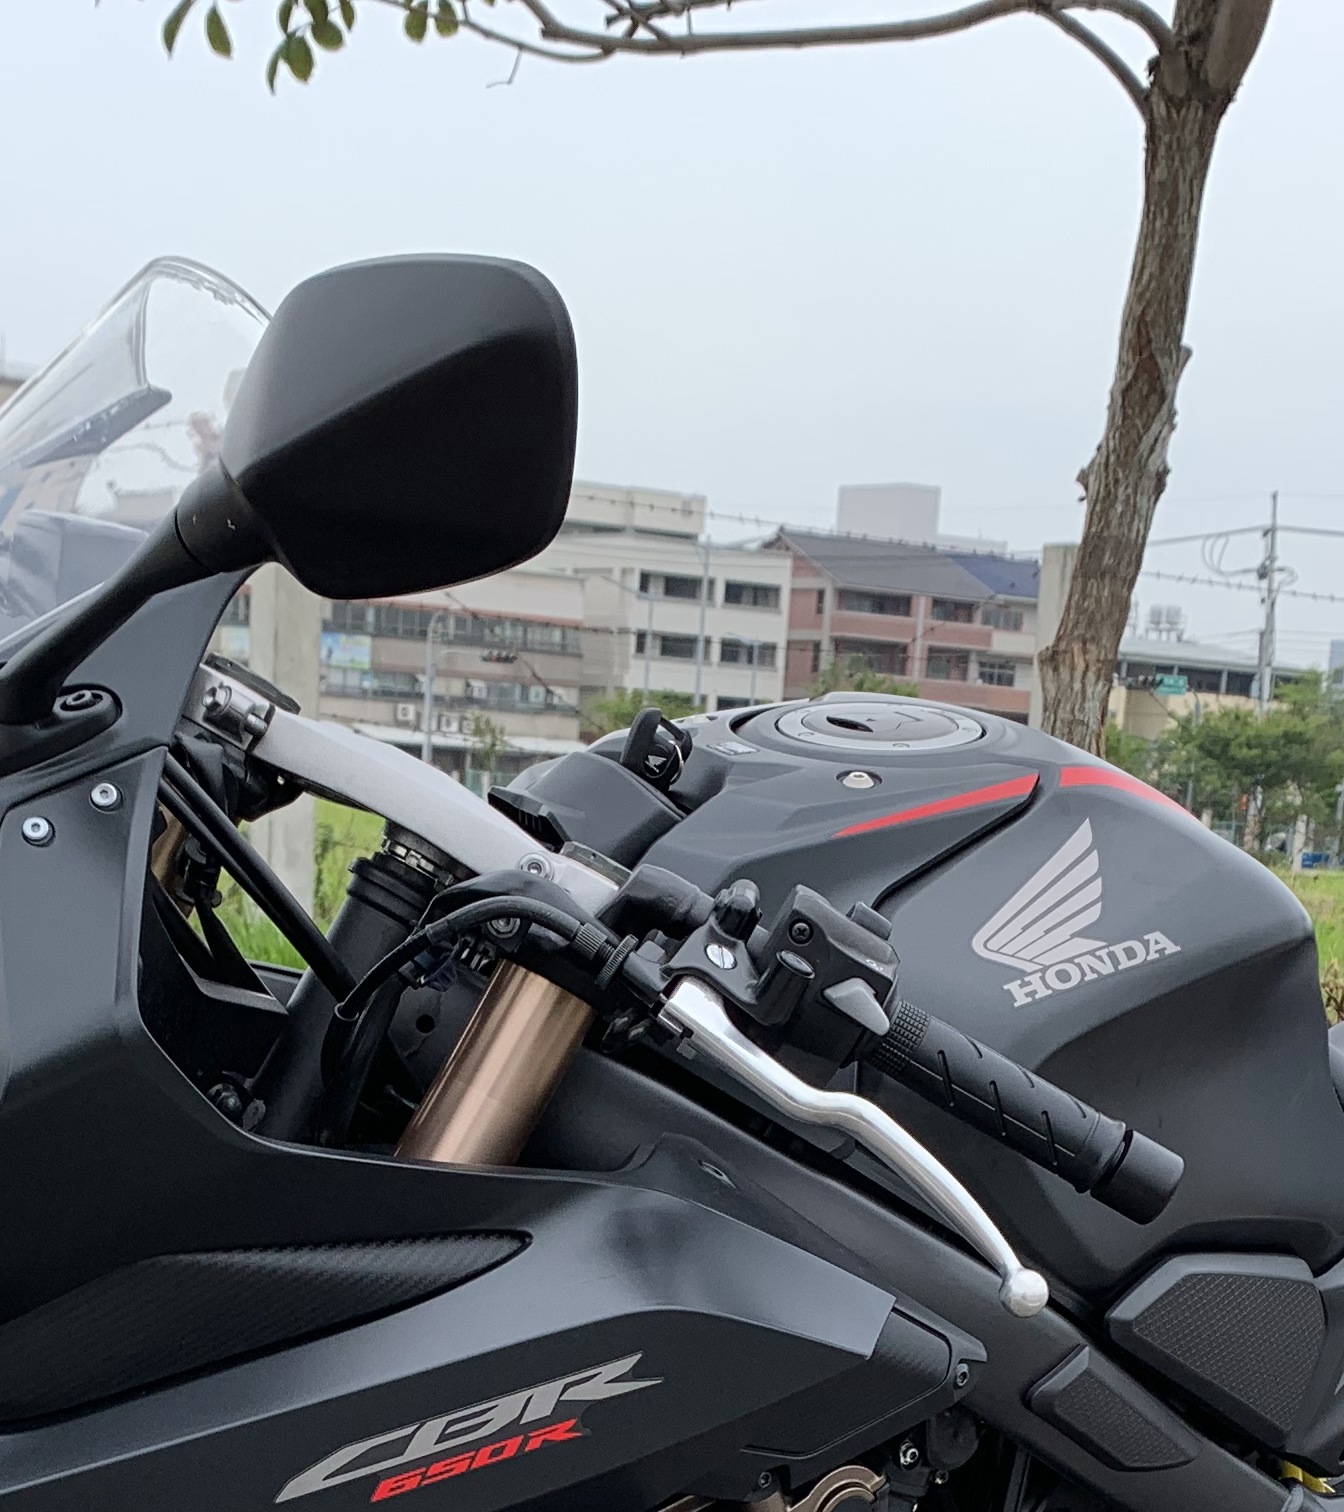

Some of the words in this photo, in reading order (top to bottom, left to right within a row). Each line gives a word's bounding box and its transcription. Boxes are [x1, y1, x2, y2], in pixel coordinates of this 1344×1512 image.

[1003, 930, 1182, 1008] HONDA
[274, 1350, 665, 1504] CBR
[370, 1418, 584, 1503] 650R
